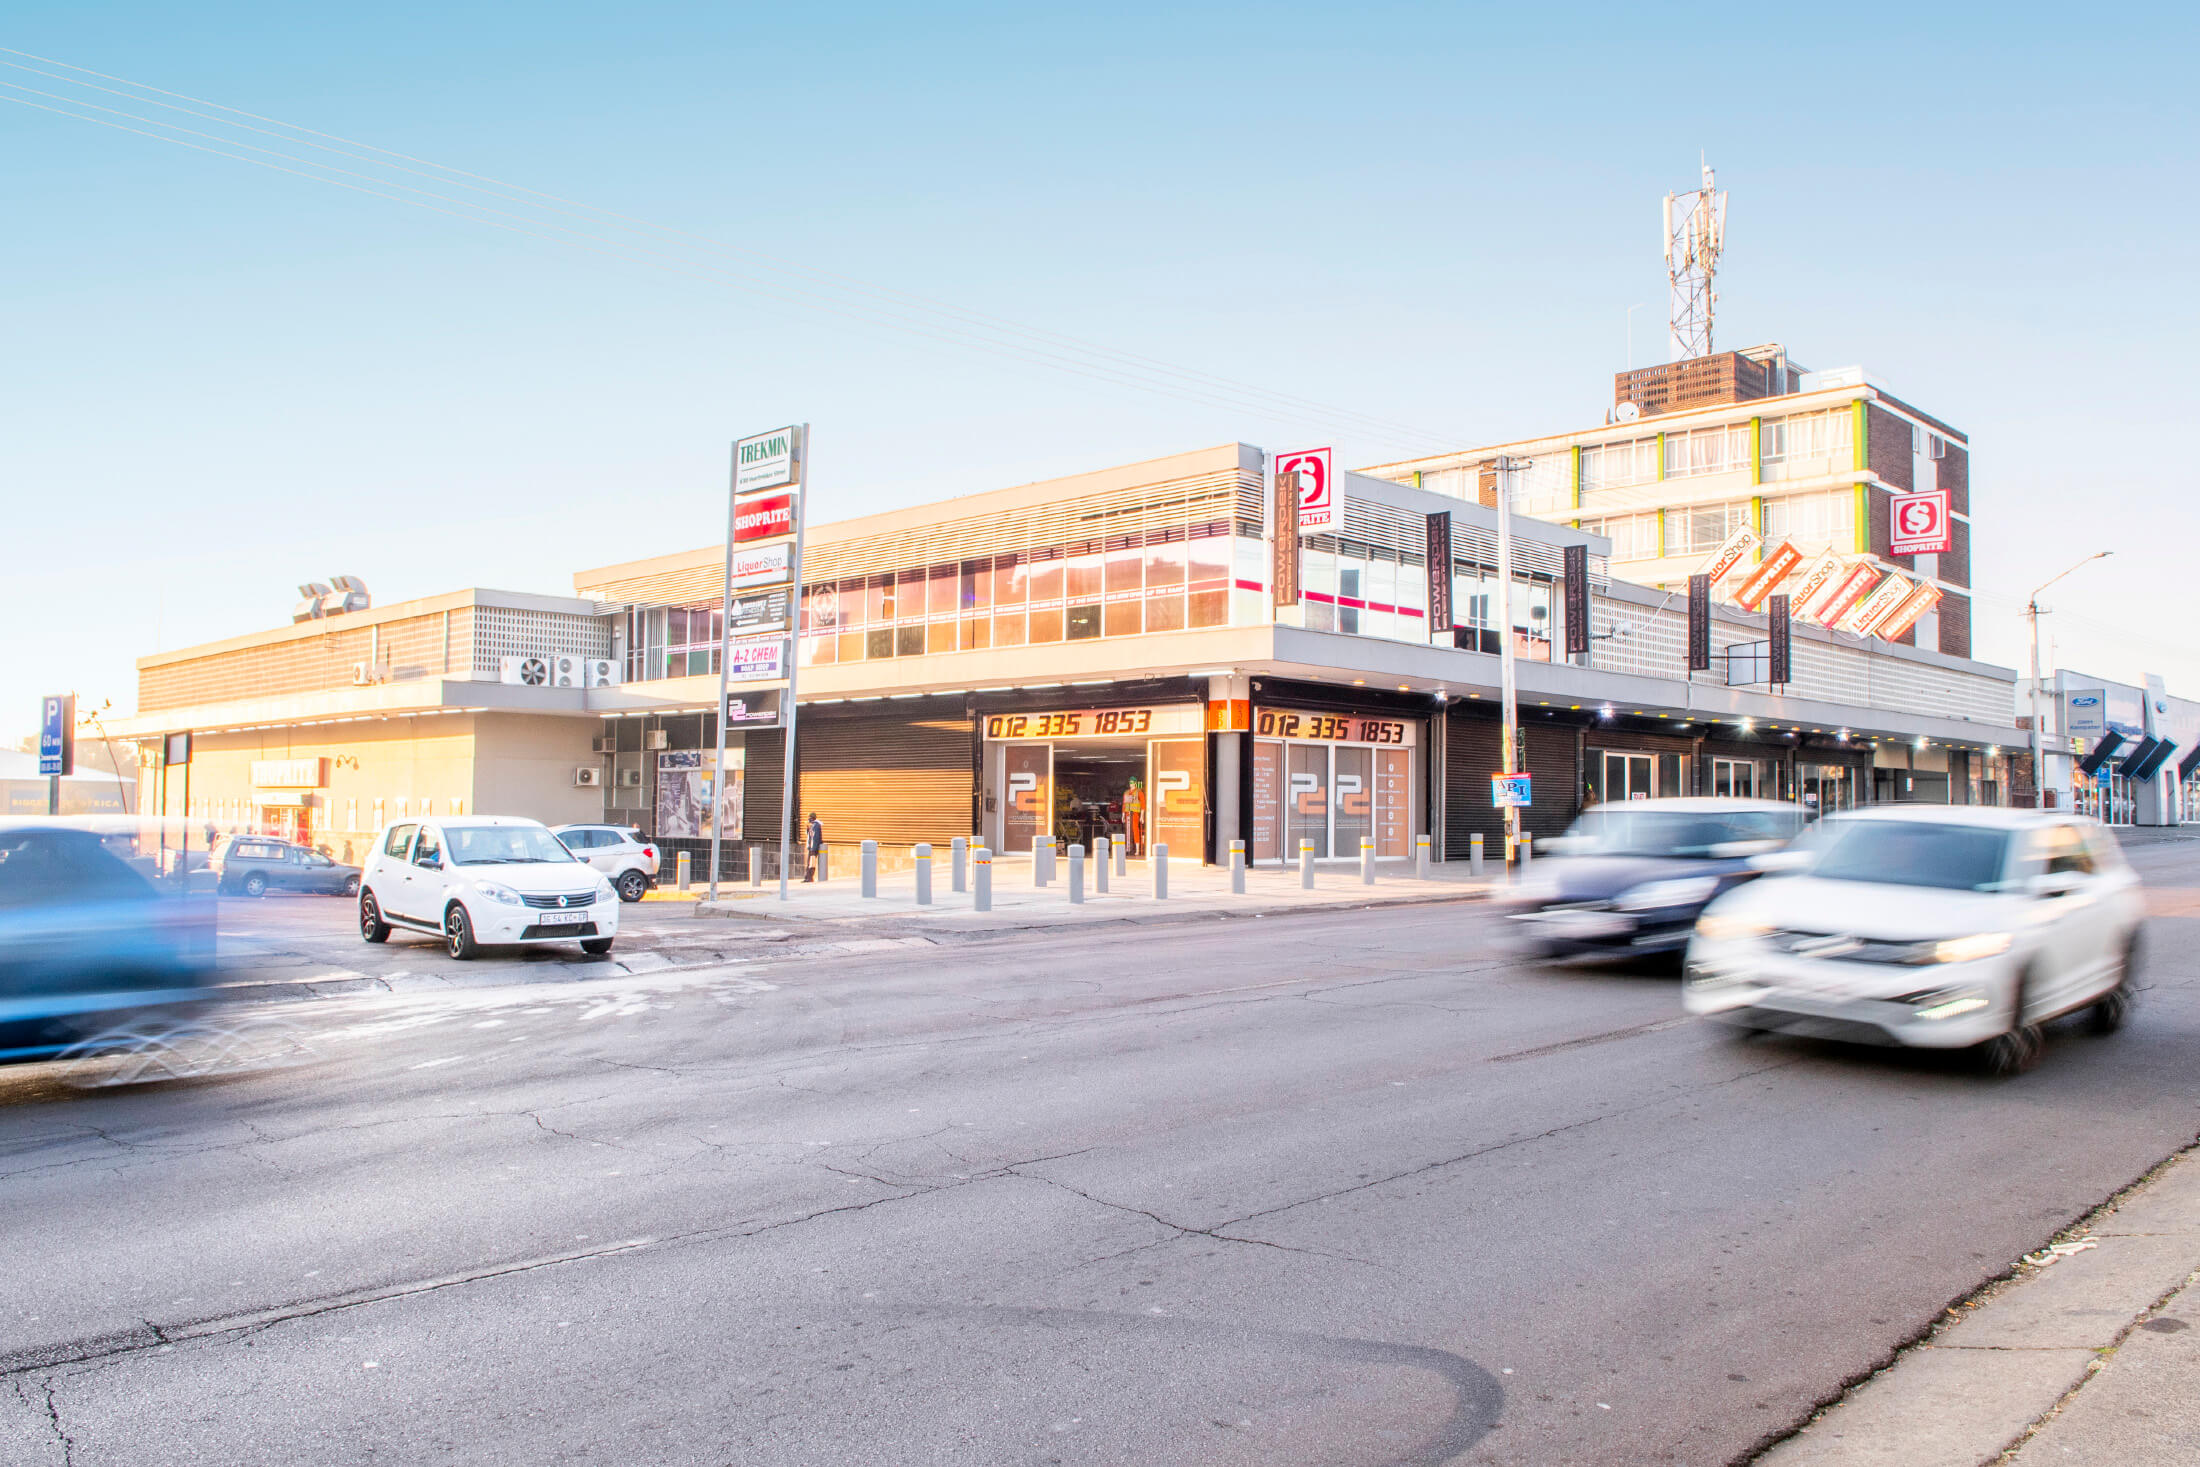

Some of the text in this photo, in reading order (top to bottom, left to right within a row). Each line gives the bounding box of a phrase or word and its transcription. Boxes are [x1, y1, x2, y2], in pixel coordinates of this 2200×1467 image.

[740, 434, 788, 464] TREKMIN
[735, 507, 791, 530] SHOPRITE
[1893, 541, 1944, 554] SHOPRITE
[1741, 549, 1795, 604] SHOPRITE
[751, 646, 778, 662] CHEM
[47, 699, 58, 726] P
[988, 710, 1152, 738] 012 335 1853
[1259, 713, 1404, 743] 012 335 1853
